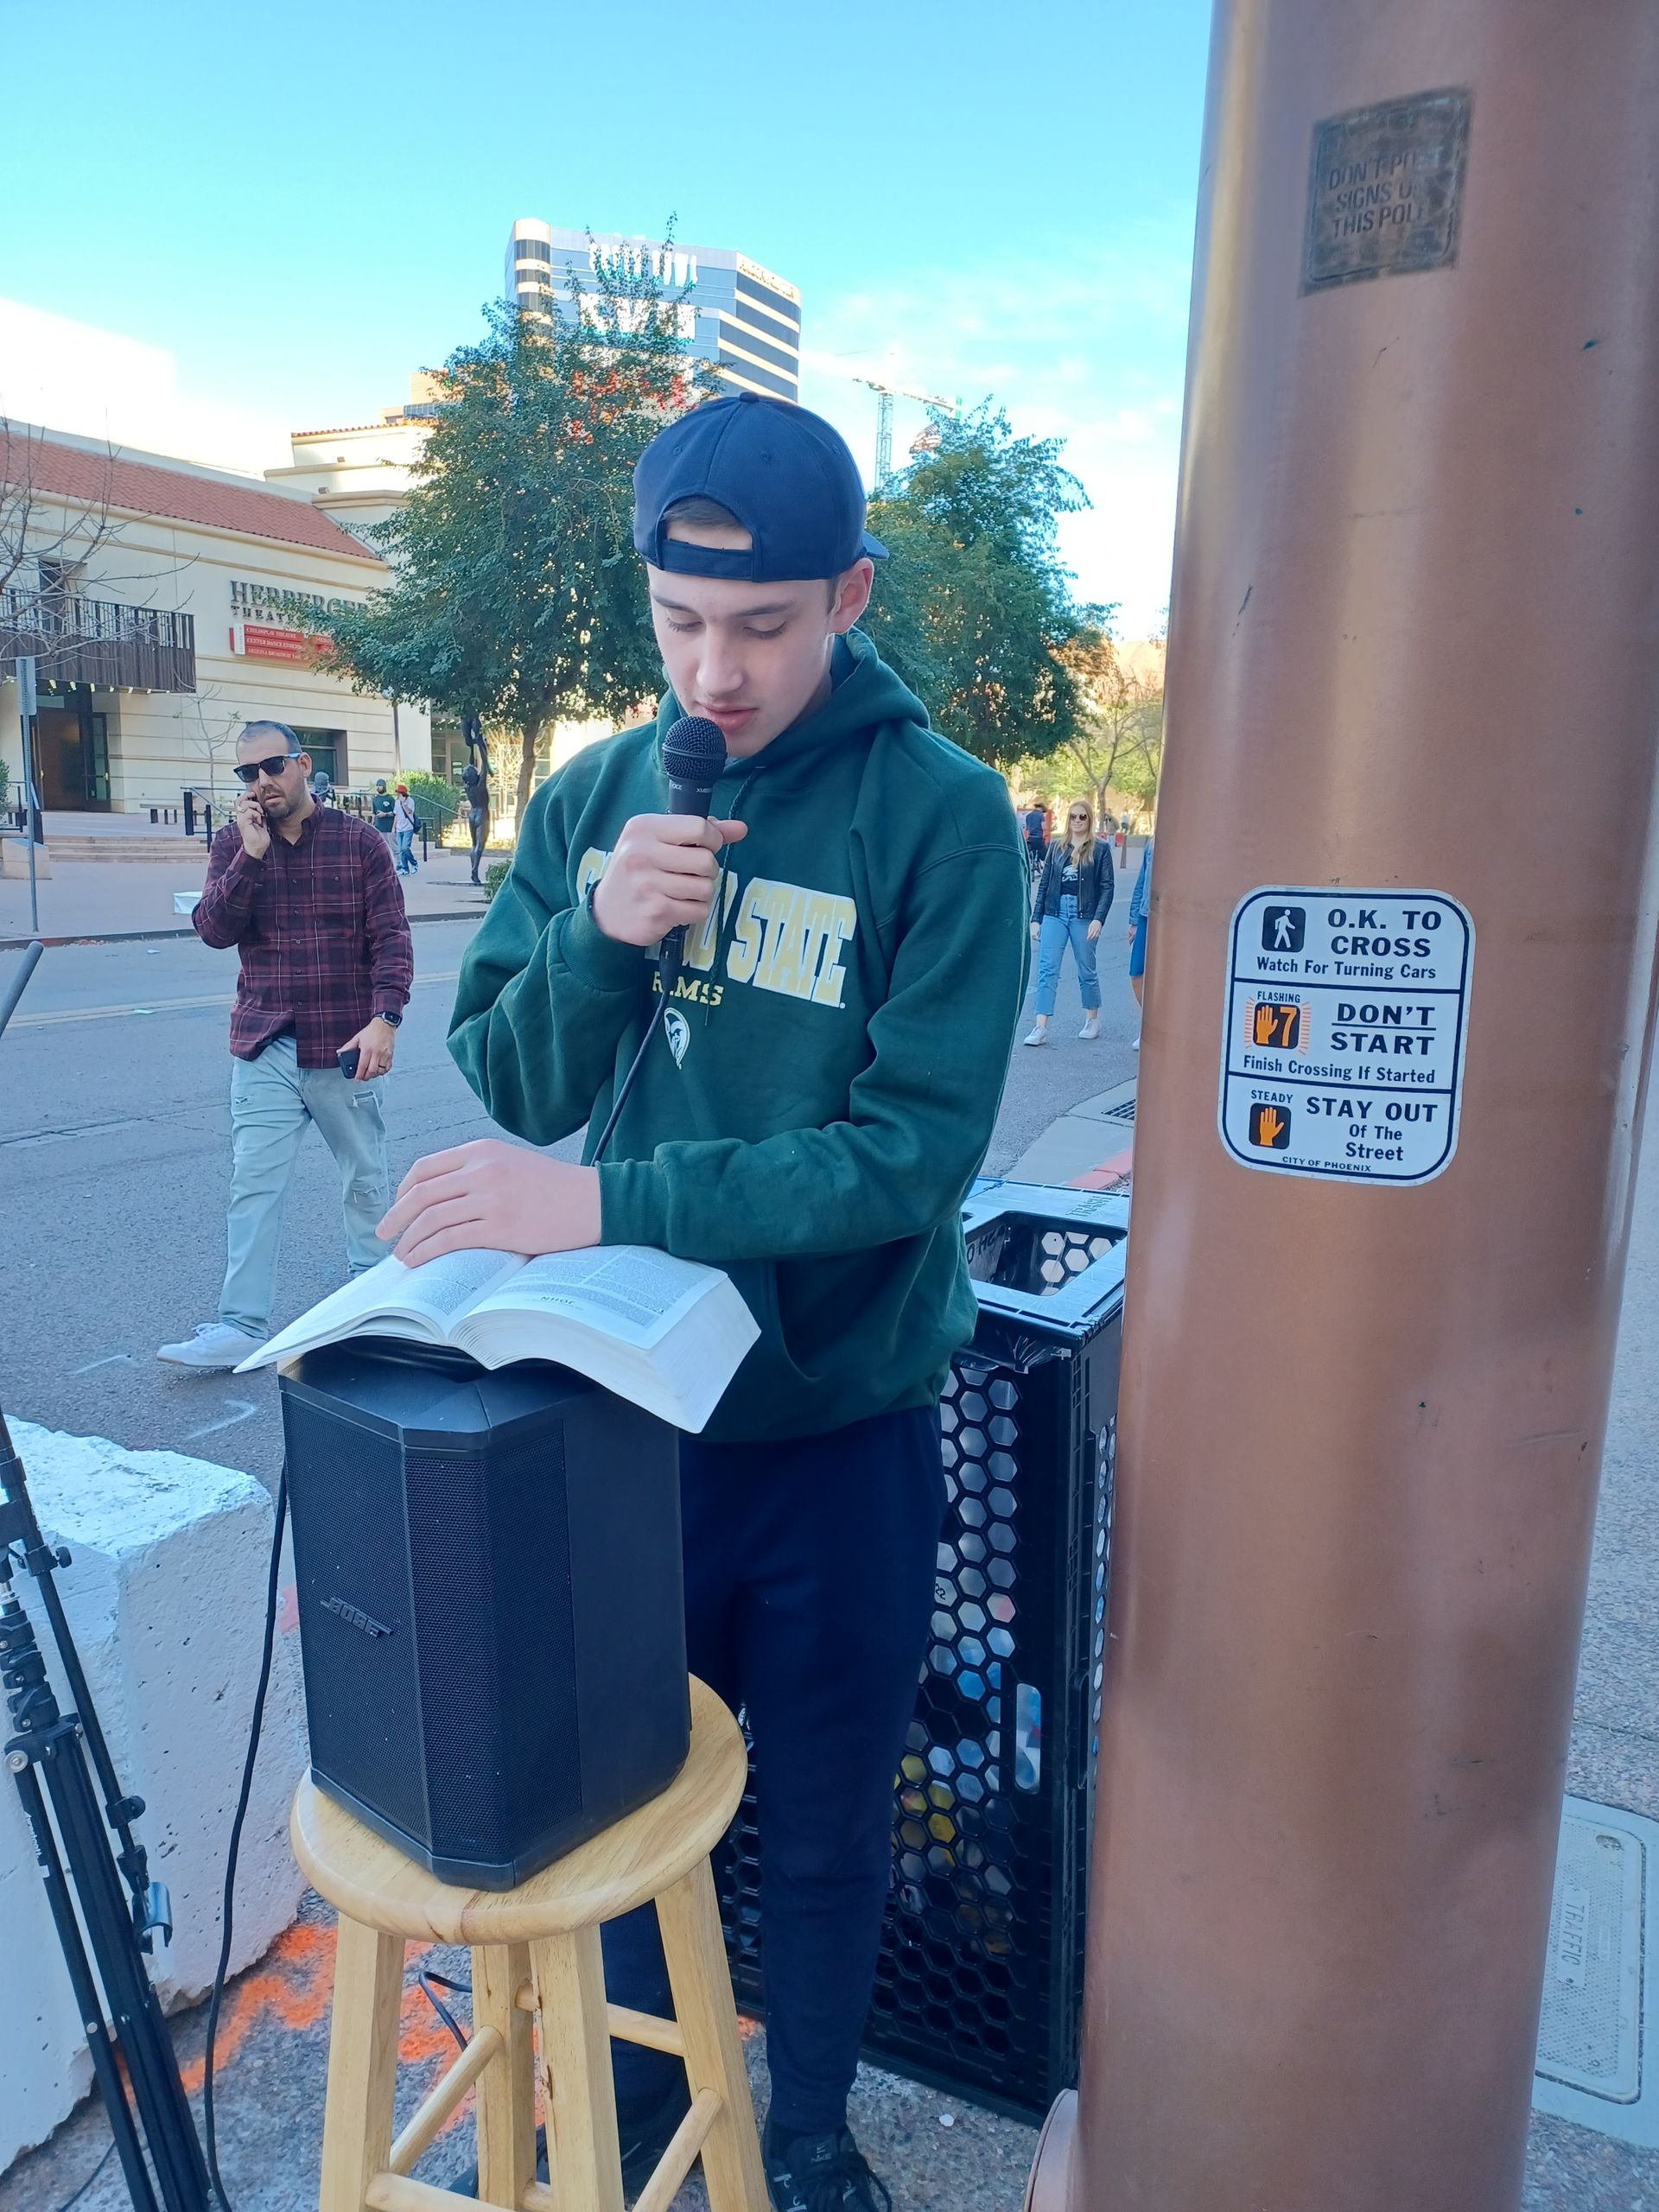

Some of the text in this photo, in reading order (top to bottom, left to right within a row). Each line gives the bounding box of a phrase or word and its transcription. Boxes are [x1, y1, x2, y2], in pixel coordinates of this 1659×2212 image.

[1329, 156, 1383, 190] DON'T
[1336, 181, 1392, 213] SIGNS
[1332, 211, 1375, 238] THIS
[231, 605, 296, 623] THEATE
[1327, 908, 1442, 931] O.K. TO
[726, 877, 857, 1008] STATE
[1331, 935, 1431, 958] CROSS
[1256, 957, 1437, 980] Watch For Turning Cars
[652, 971, 724, 1006] RMS
[1257, 990, 1301, 1004] FLASHING
[1337, 1002, 1435, 1027] DON'T
[1330, 1032, 1435, 1056] START
[1243, 1055, 1435, 1084] Finish Crossing If Started
[1250, 1090, 1294, 1104] STEADY
[1306, 1096, 1439, 1123] STAY OUT
[1349, 1123, 1403, 1141] Of The
[1345, 1142, 1404, 1161] Street
[1282, 1155, 1372, 1173] CITY OF PHOENIX
[1065, 1196, 1113, 1217] TRASH
[320, 1597, 394, 1638] BOSE
[1561, 1904, 1585, 1967] TRAFFIC
